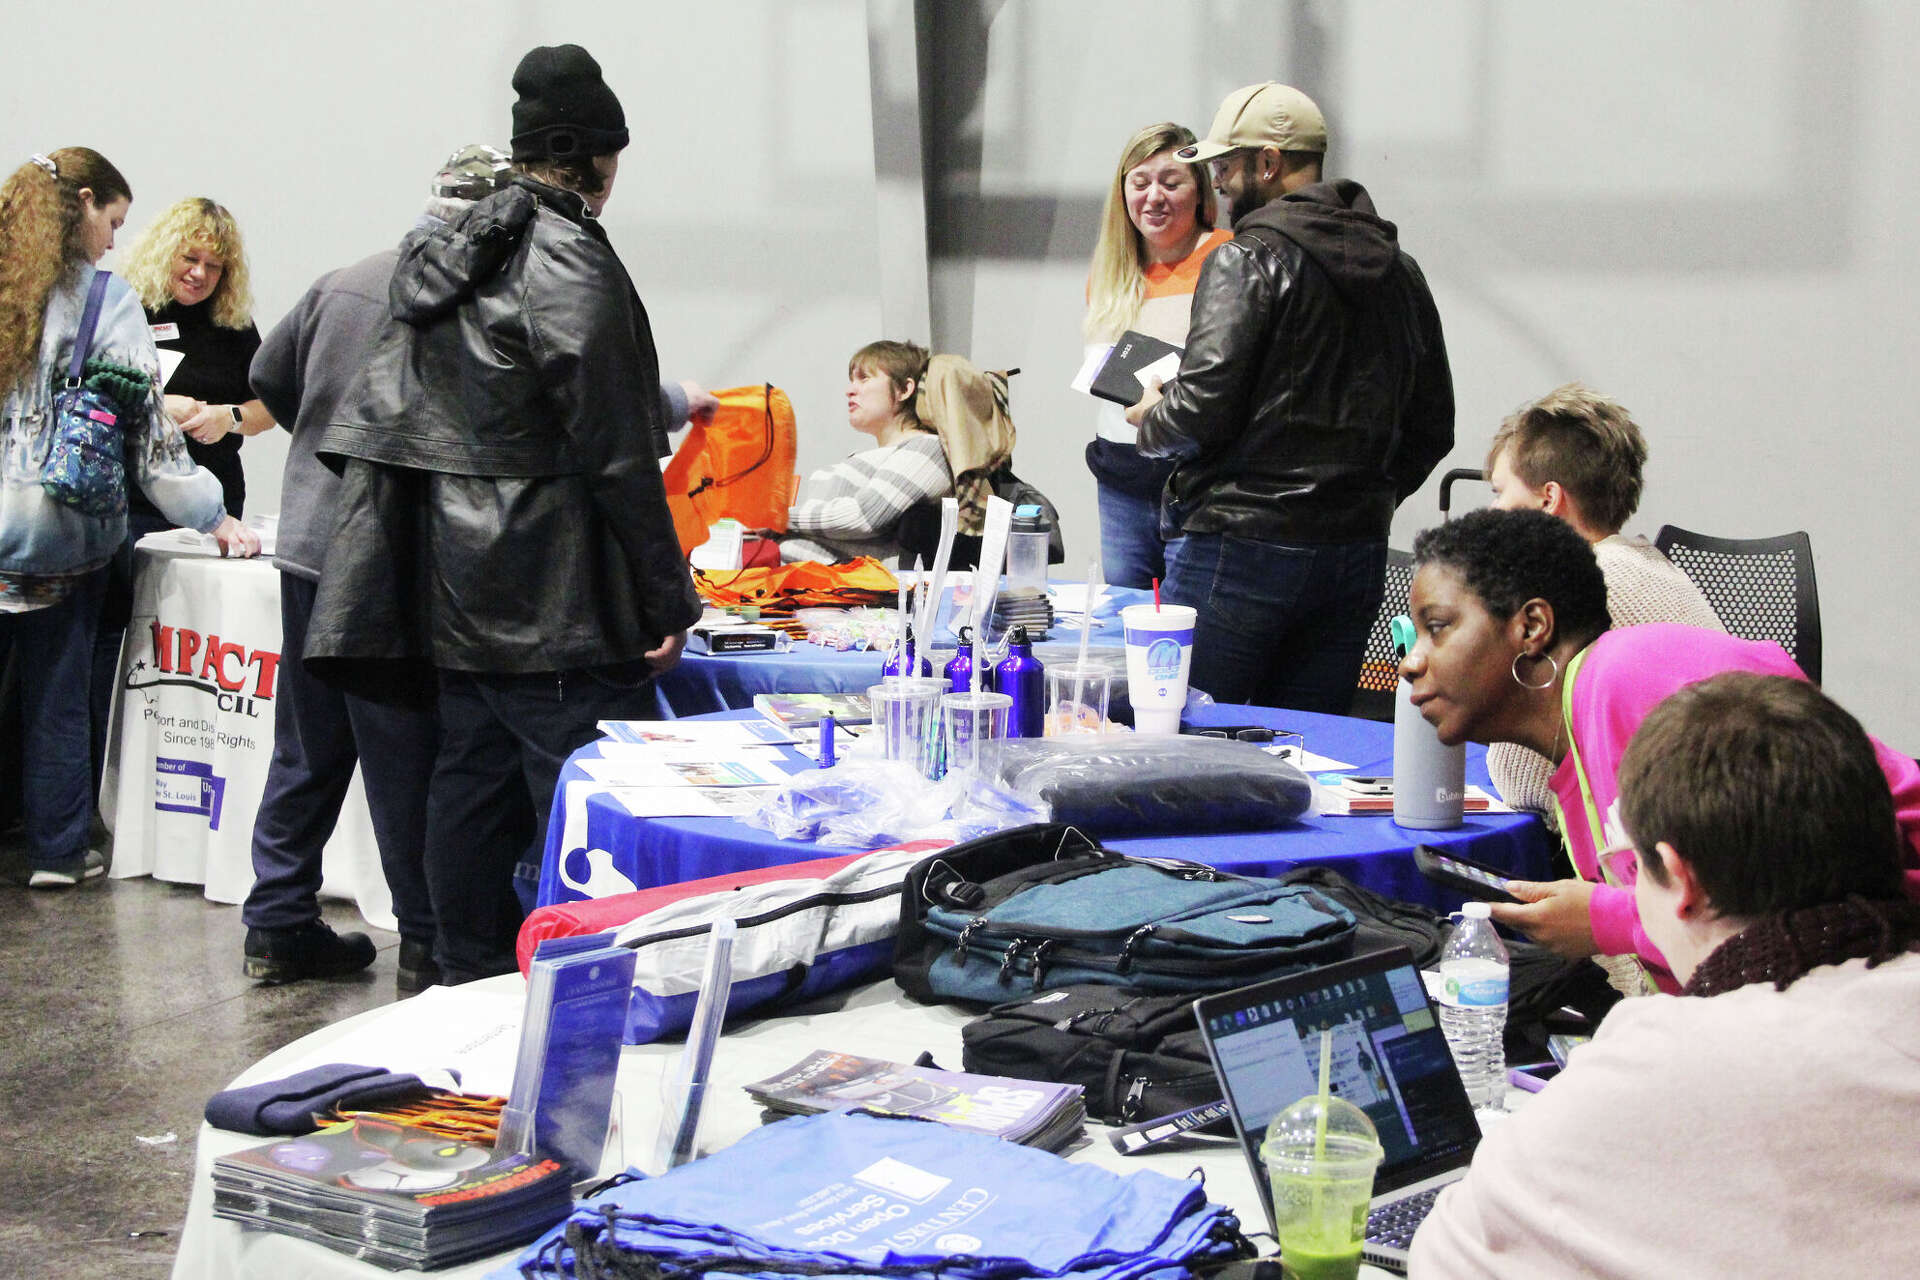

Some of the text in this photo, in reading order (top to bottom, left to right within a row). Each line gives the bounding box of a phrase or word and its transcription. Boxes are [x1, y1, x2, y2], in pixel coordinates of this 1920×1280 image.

[217, 693, 259, 719] CIL
[164, 731, 197, 746] Since
[179, 718, 199, 730] and
[217, 731, 256, 751] Rights
[177, 763, 186, 771] of
[176, 792, 197, 801] Louis
[794, 1193, 886, 1237] Services
[849, 1203, 911, 1234] Open
